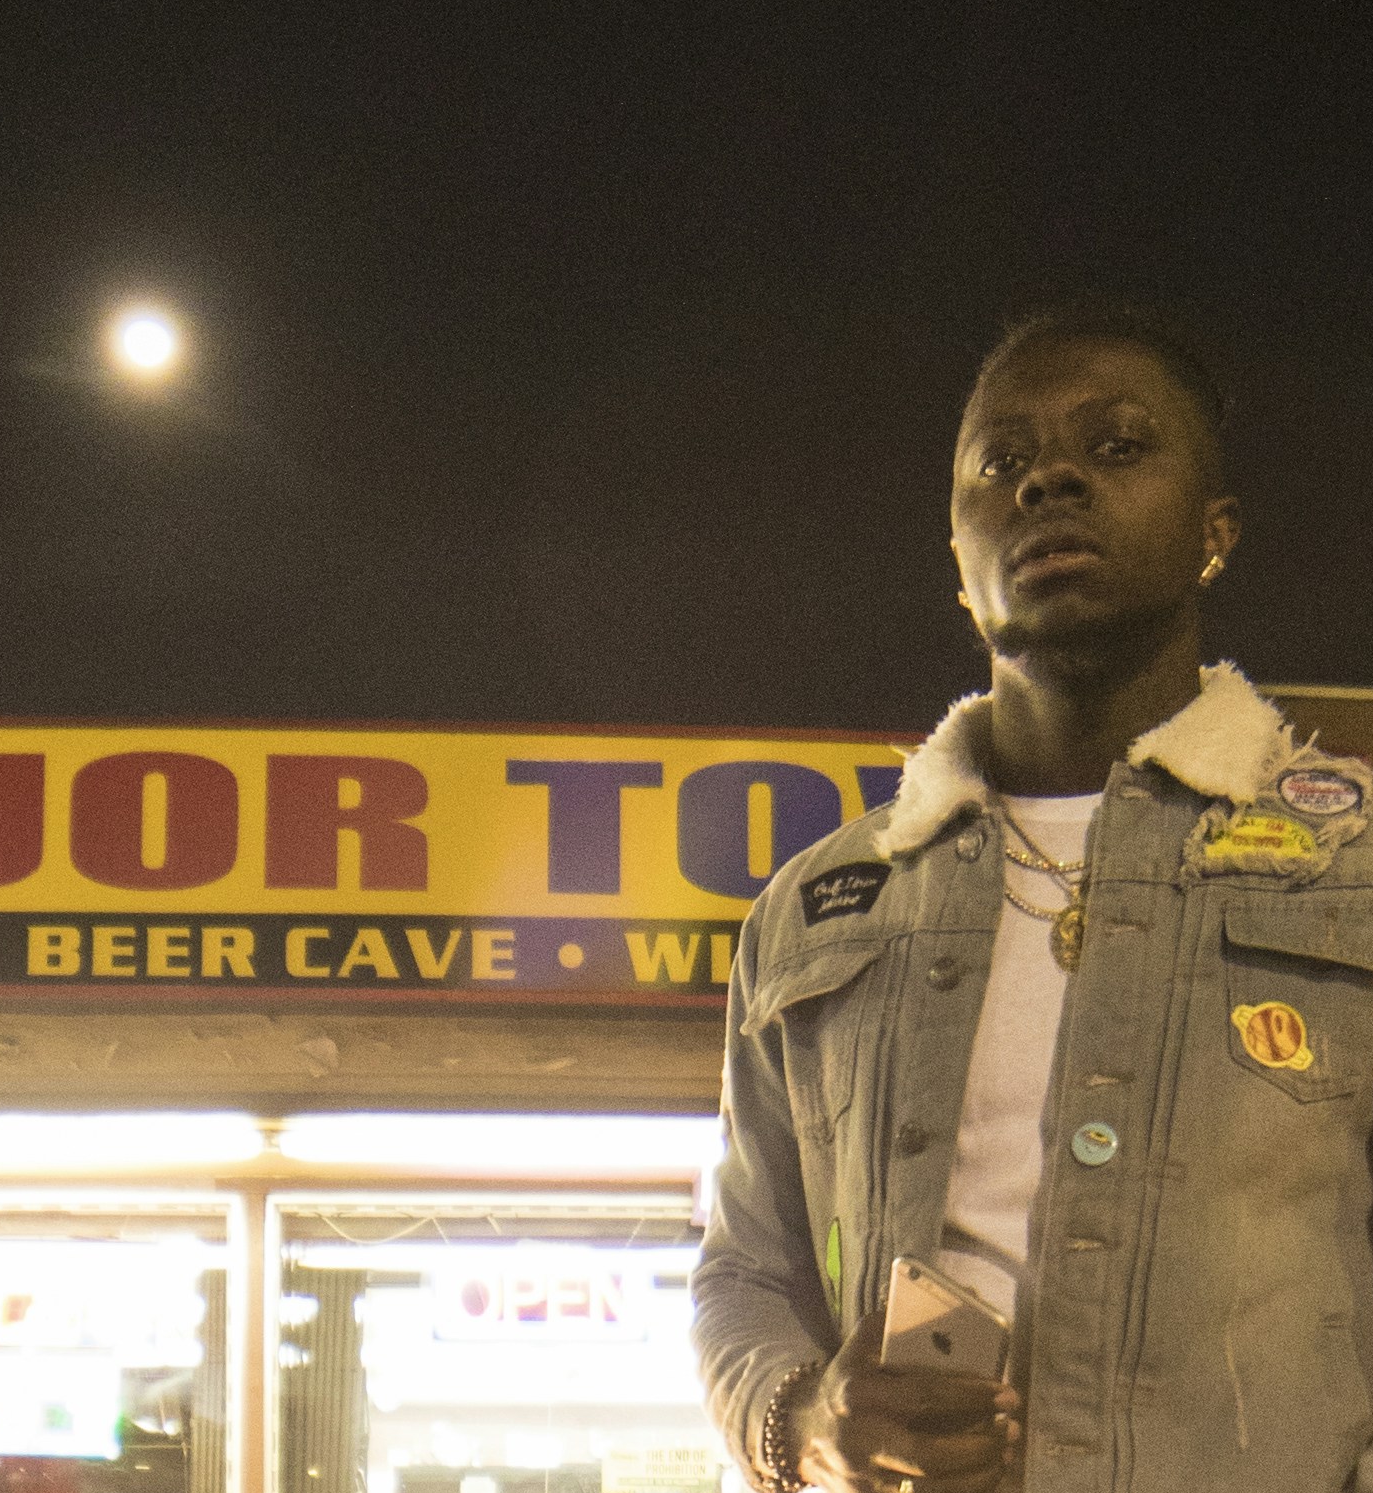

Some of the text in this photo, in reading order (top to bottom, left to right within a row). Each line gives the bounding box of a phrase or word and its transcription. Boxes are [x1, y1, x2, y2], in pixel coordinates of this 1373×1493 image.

[505, 759, 905, 896] TO
[26, 925, 257, 978] BEER
[284, 927, 517, 980] CAVE
[449, 1270, 635, 1322] OPEN
[645, 1449, 664, 1462] THE
[668, 1449, 690, 1462] END
[693, 1449, 707, 1462] OF
[645, 1463, 707, 1475] PROHIBITION
